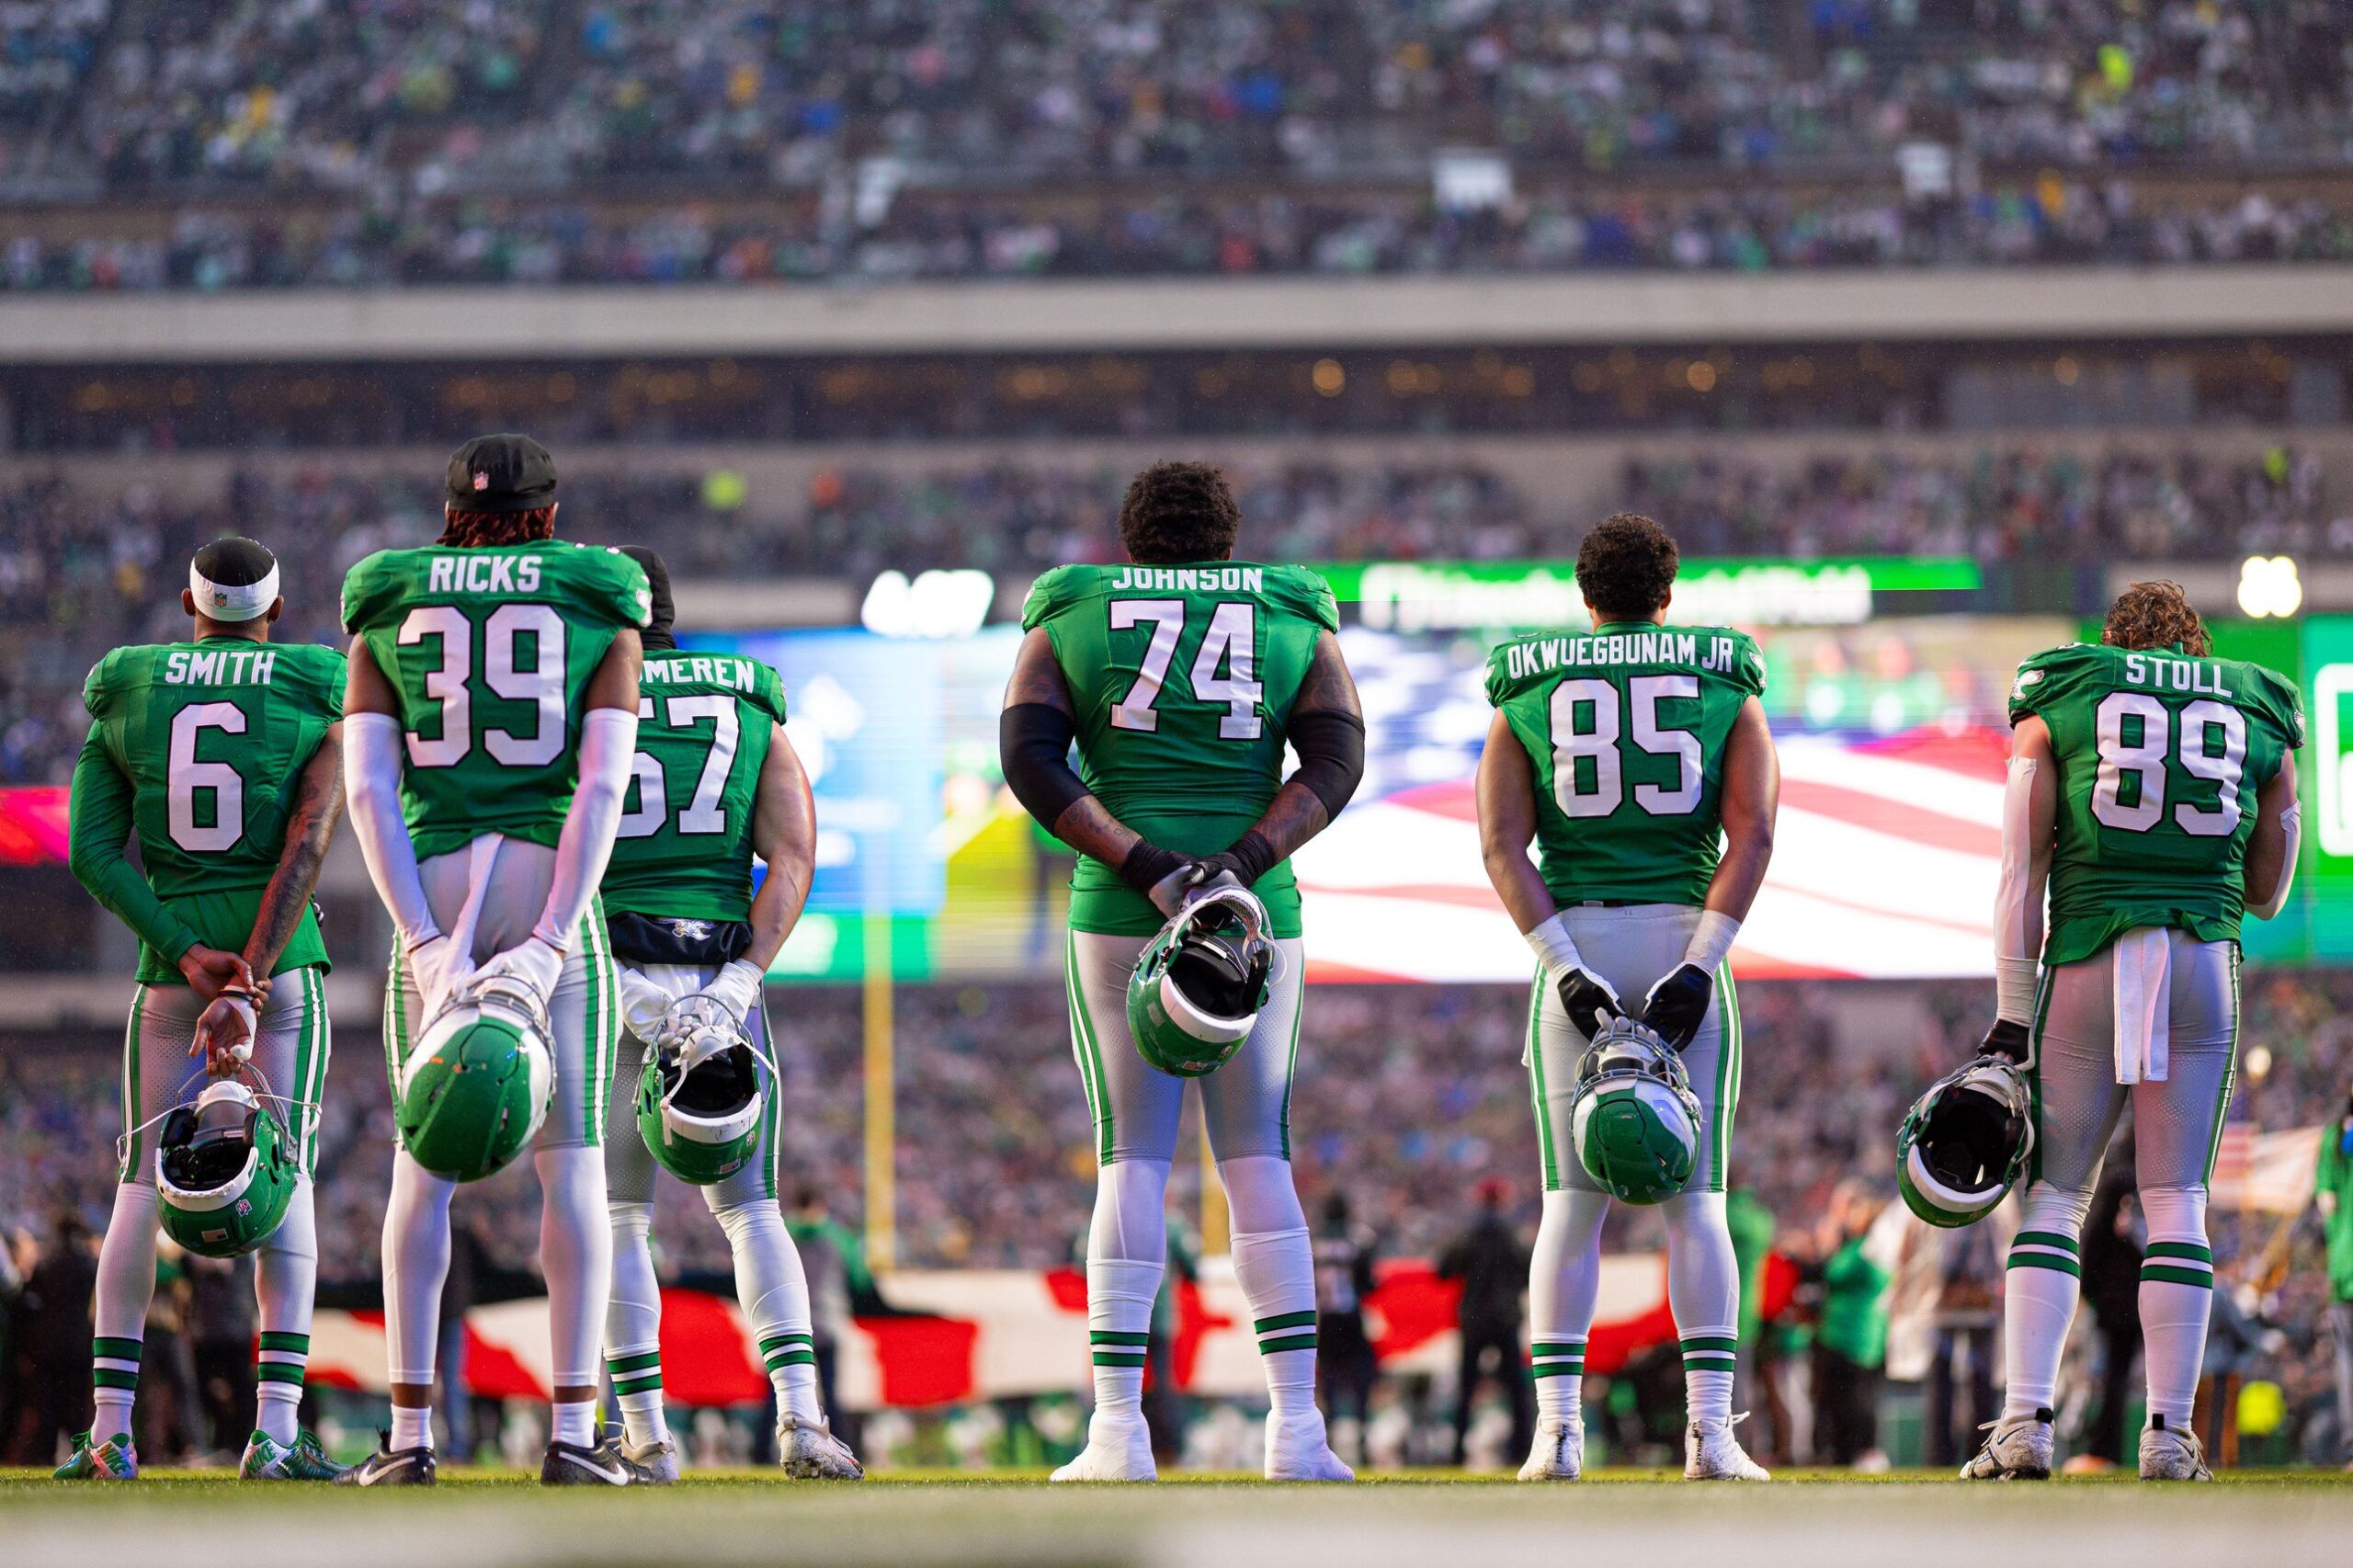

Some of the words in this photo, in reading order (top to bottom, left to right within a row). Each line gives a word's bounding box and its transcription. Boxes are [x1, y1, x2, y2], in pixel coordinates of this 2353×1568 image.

[429, 555, 542, 592] RICKS
[1112, 567, 1263, 593] JOHNSON
[165, 652, 276, 685] SMITH
[639, 658, 755, 693] MEREN
[1108, 598, 1265, 741] 74
[1507, 633, 1695, 679] OKWUEGBUNAM
[1701, 636, 1733, 673] JR
[2126, 653, 2233, 699] STOLL
[396, 603, 567, 769] 39
[1549, 675, 1703, 820] 85
[2089, 691, 2246, 838] 89
[167, 700, 247, 853] 6
